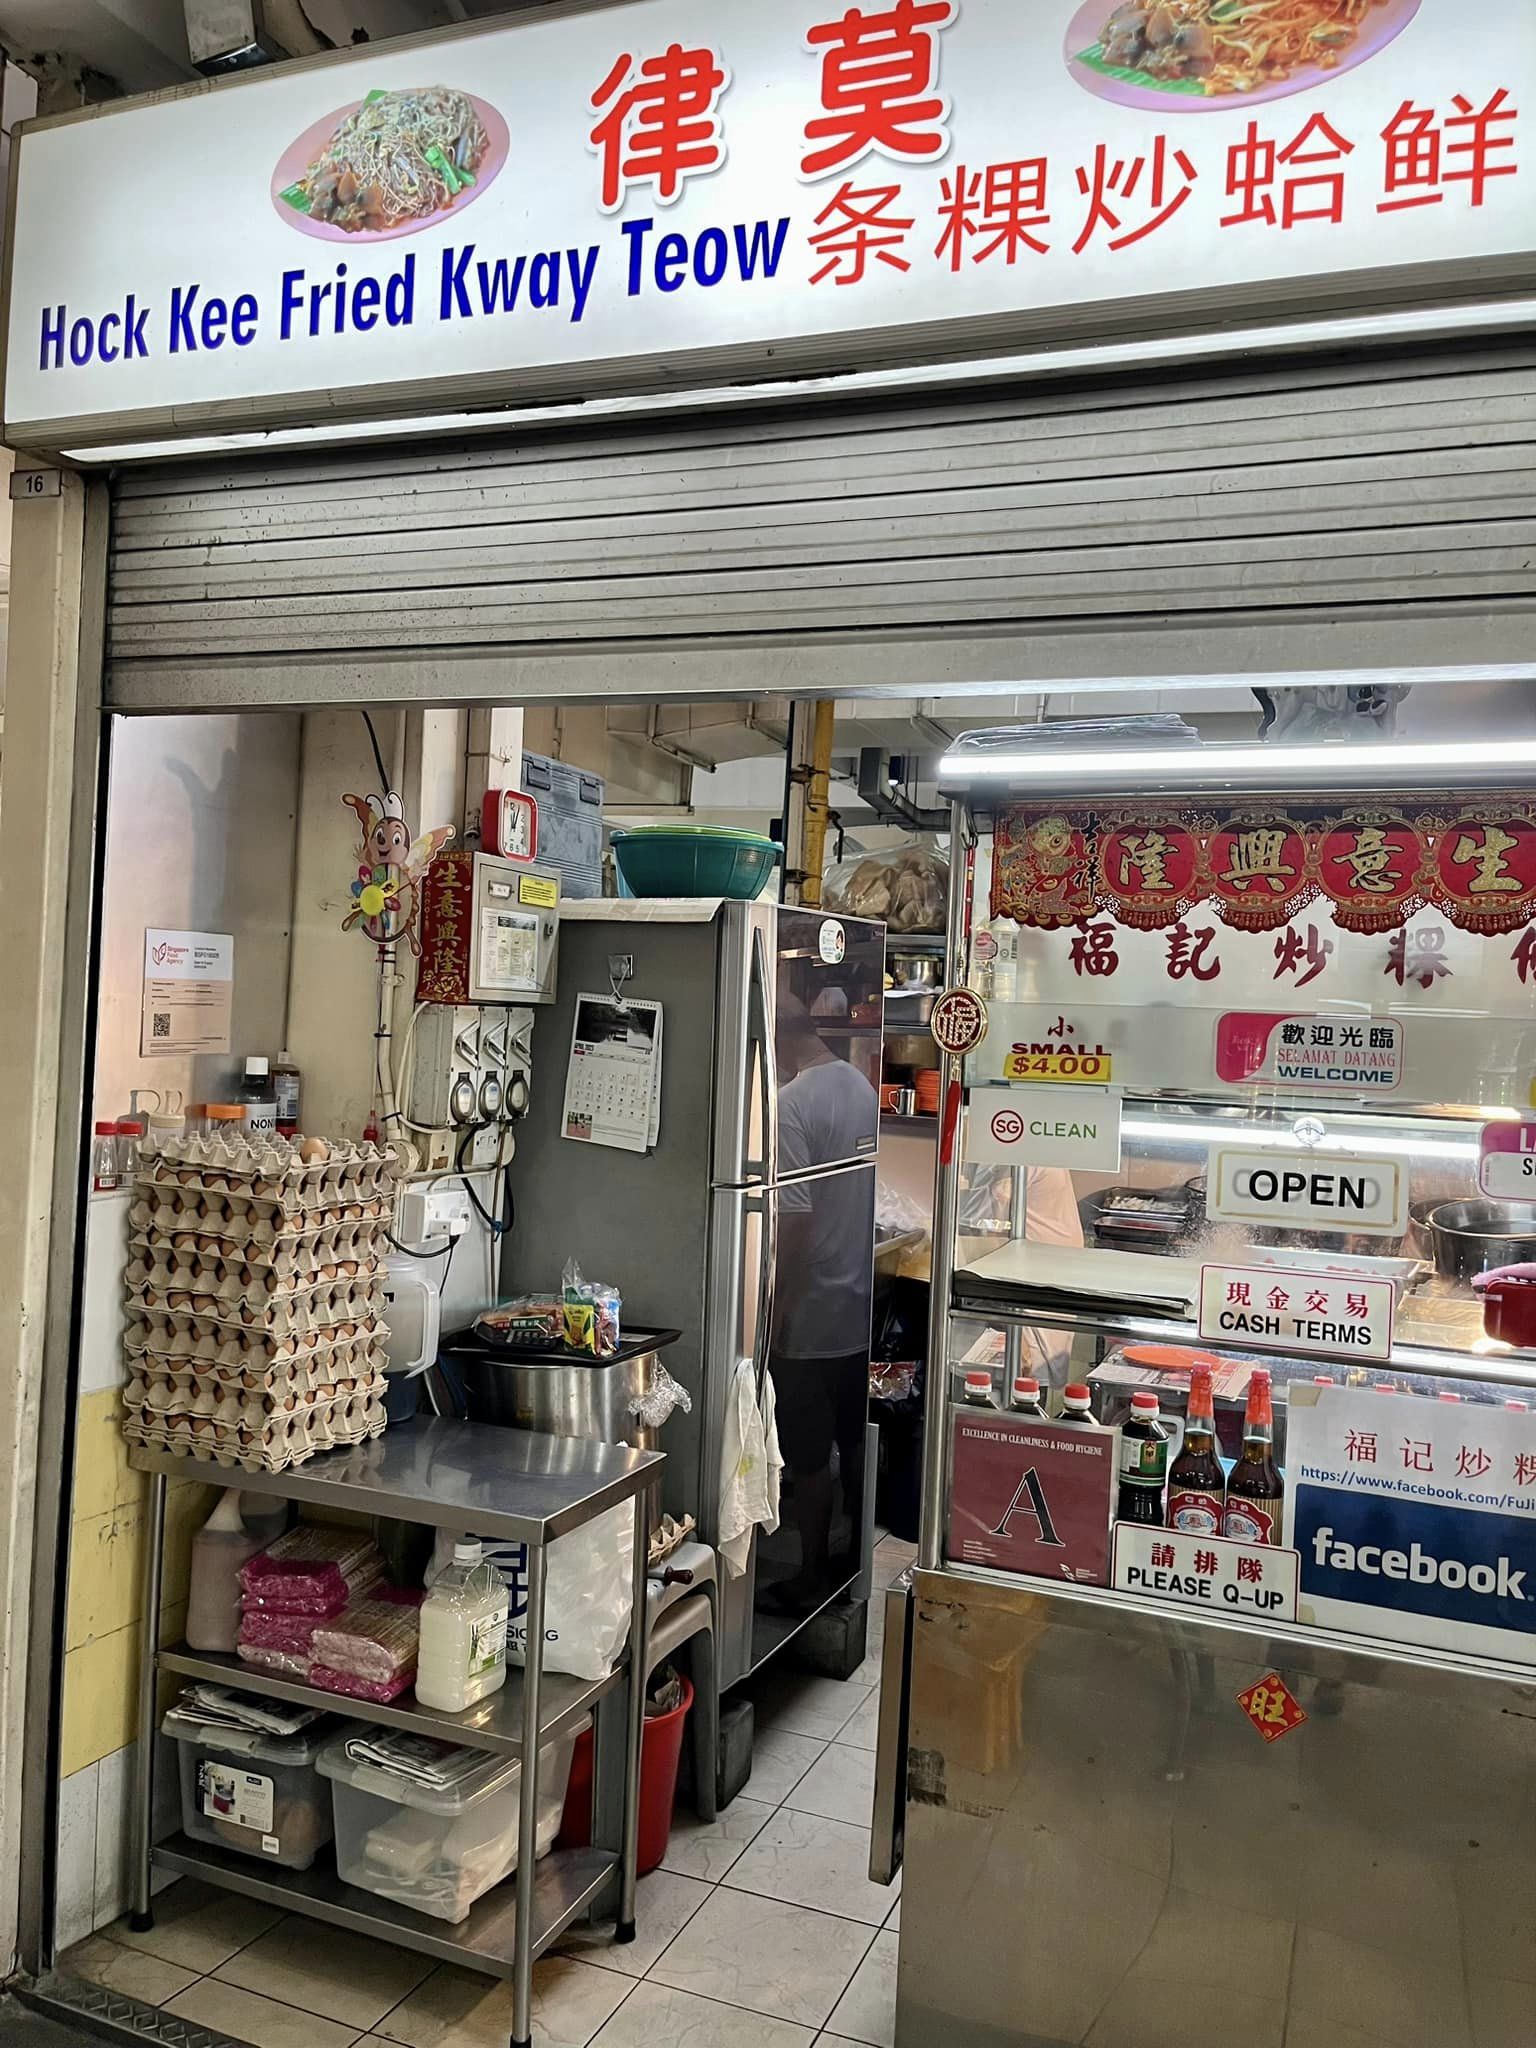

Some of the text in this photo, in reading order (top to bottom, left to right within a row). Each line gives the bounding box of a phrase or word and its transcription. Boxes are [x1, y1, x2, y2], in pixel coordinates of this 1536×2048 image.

[39, 217, 791, 371] Hock Kee Fried Kway Teow
[26, 475, 43, 493] 16
[1048, 1016, 1074, 1038] 小
[1281, 1023, 1395, 1049] 歡迎光臨
[1011, 1042, 1112, 1056] SMALL
[1277, 1048, 1396, 1068] SELAMAT DATANG
[1012, 1055, 1101, 1076] $4.00
[1278, 1065, 1393, 1083] WELCOME
[995, 1120, 1097, 1139] SG CLEAN
[1249, 1169, 1366, 1209] OPEN
[1226, 1281, 1369, 1319] 現金交易
[1219, 1311, 1372, 1346] CASH TERMS
[962, 1427, 1103, 1456] EXCELLENCE IN CLEANLINESS & FOOD HYGIENE
[989, 1466, 1066, 1548] A
[1151, 1543, 1264, 1584] 請排隊
[1127, 1566, 1212, 1600] PLEASE
[1223, 1583, 1285, 1611] Q-UP
[1249, 1686, 1289, 1728] 旺
